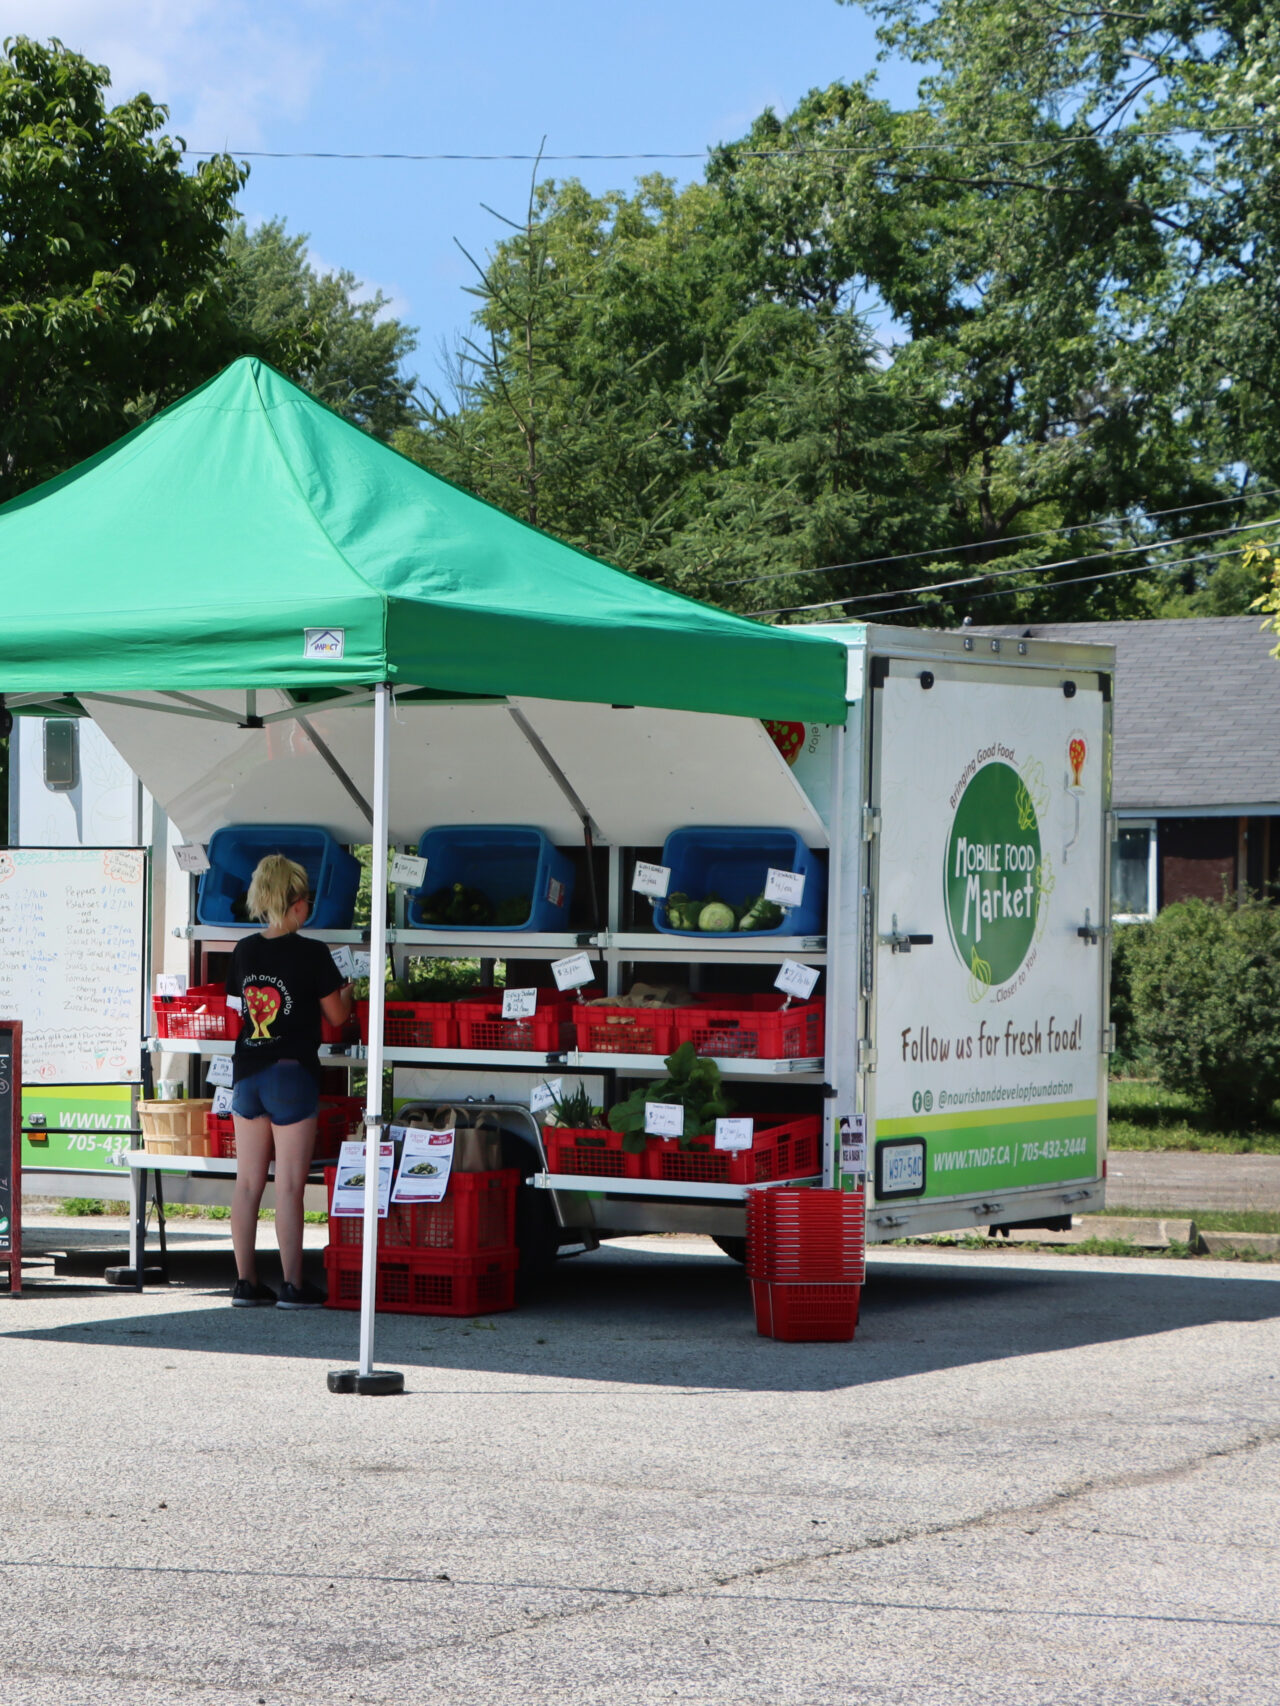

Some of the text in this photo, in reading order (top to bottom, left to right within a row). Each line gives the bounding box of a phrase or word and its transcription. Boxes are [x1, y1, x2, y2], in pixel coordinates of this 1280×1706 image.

[949, 759, 976, 810] Bringing
[977, 742, 996, 763] Good
[955, 837, 1035, 878] MOBILE FOOD
[65, 885, 96, 898] Peppers
[962, 872, 1034, 943] Market
[259, 974, 277, 984] and
[277, 980, 294, 1015] Develop
[901, 1014, 1082, 1063] Follow us for fresh food!
[938, 1080, 1073, 1109] @nourishanddevelopfoundation
[933, 1137, 1087, 1172] WWW.TNDF.CA 705-432-2444
